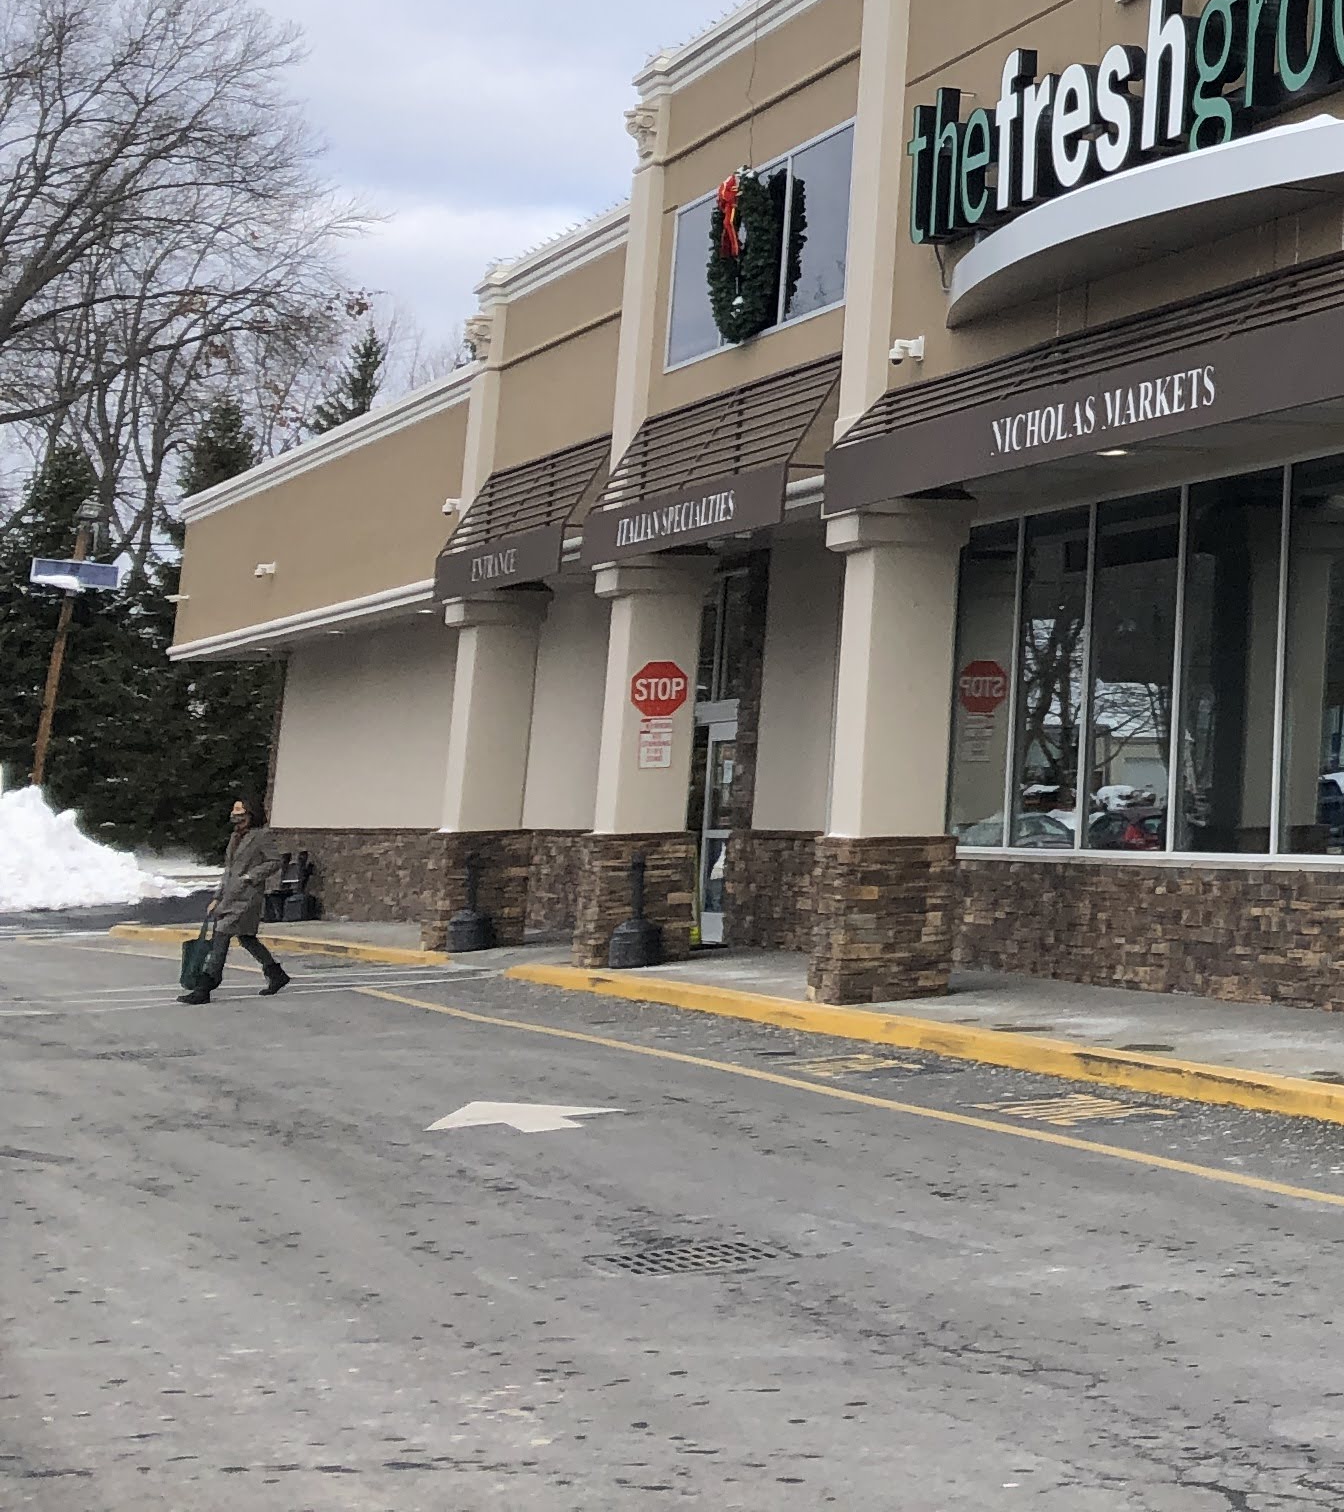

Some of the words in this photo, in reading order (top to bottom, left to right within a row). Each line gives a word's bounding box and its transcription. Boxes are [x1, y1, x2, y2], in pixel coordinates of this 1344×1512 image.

[990, 395, 1096, 456] NICHOLAS
[1101, 365, 1215, 430] MARKETS
[616, 509, 660, 547] ITALIAN
[660, 489, 735, 536] SPECIALTIES
[634, 677, 685, 701] STOP
